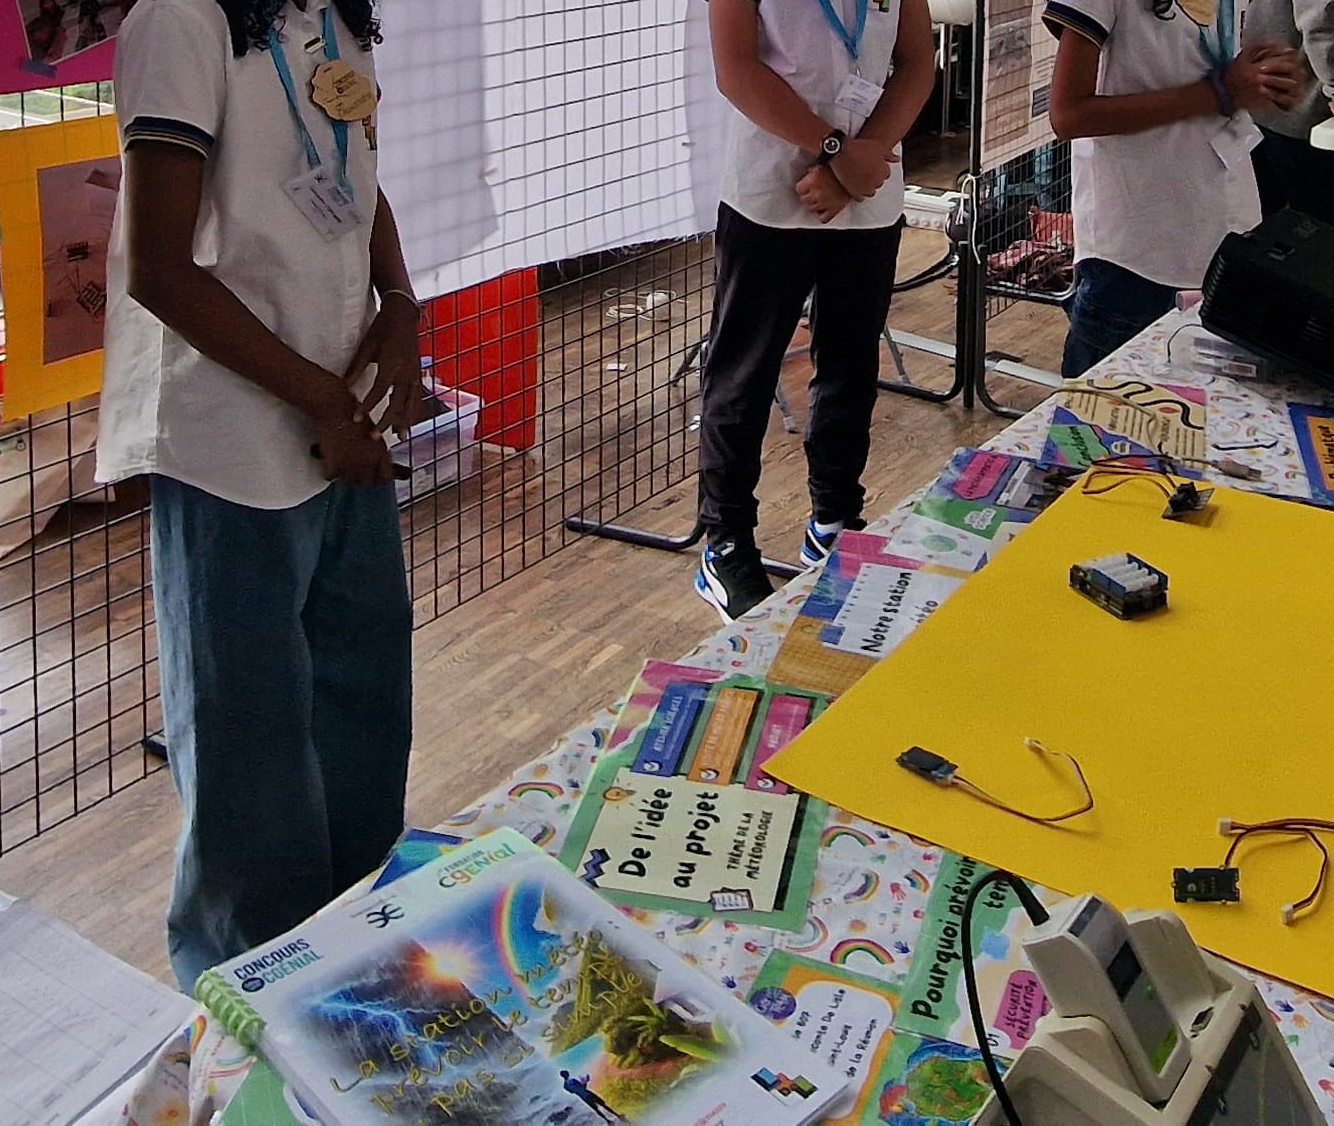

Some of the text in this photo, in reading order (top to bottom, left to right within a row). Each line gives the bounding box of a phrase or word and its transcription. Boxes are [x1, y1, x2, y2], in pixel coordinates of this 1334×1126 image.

[860, 572, 913, 653] Notre station
[618, 788, 673, 877] De l'idée
[685, 791, 721, 857] projet
[736, 825, 750, 837] DE
[741, 812, 755, 825] LA
[673, 862, 698, 888] au
[234, 938, 311, 982] CONCOURS
[910, 917, 963, 1021] Pourquoi
[330, 1060, 380, 1093] La
[390, 984, 513, 1063] station
[491, 1006, 528, 1033] le
